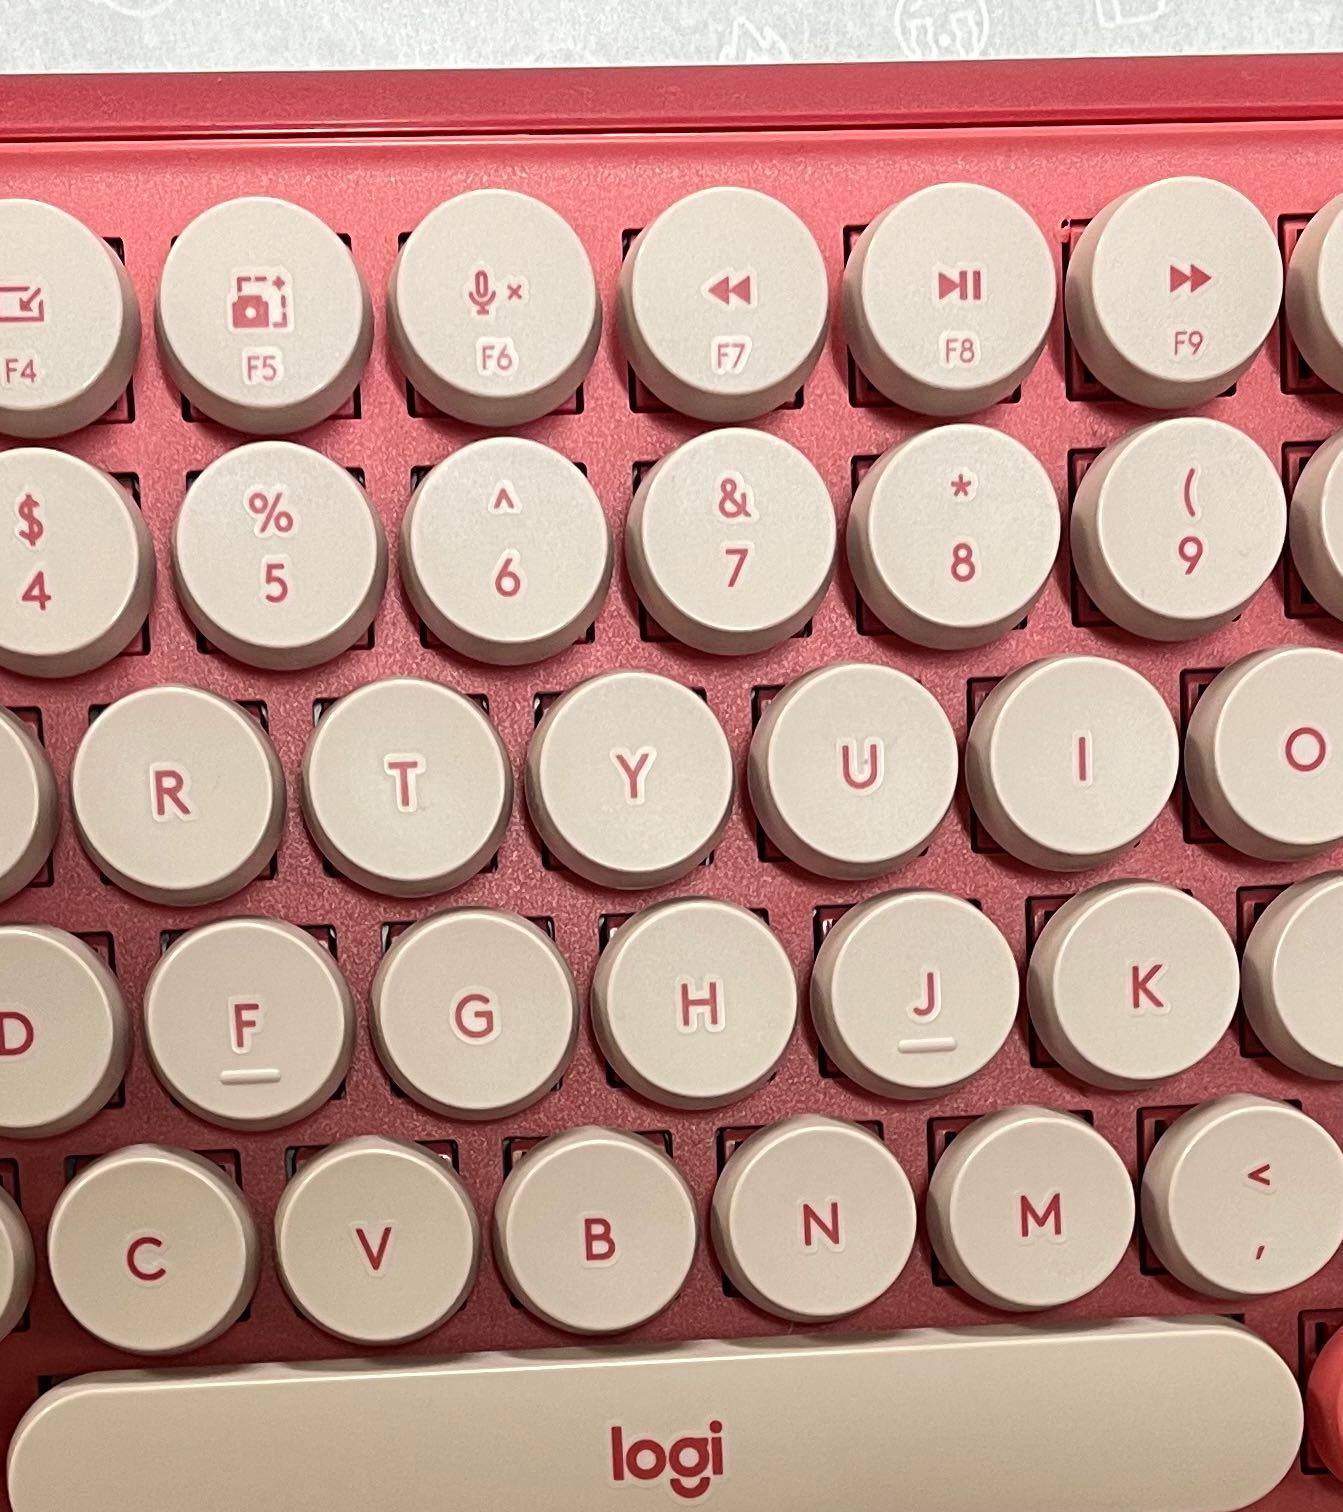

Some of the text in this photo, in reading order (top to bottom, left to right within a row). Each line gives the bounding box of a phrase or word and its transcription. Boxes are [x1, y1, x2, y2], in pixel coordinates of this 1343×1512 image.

[481, 345, 513, 371] F6
[717, 343, 746, 369] F7
[945, 337, 975, 364] F8
[1174, 330, 1204, 356] F9
[5, 358, 37, 384] F4
[247, 355, 277, 382] F5
[248, 492, 294, 533] %
[493, 487, 515, 509] ^
[718, 477, 752, 519] &
[1183, 467, 1196, 518] (
[18, 493, 44, 547] $
[494, 557, 521, 598] 6
[725, 548, 749, 588] 7
[950, 542, 976, 583] 8
[1178, 535, 1204, 576] 9
[21, 570, 52, 611] 4
[265, 563, 289, 604] 5
[841, 743, 878, 790] U
[1078, 736, 1087, 782] I
[1284, 726, 1327, 773] O
[154, 769, 191, 816] R
[388, 761, 418, 807] T
[615, 753, 649, 799] Y
[680, 981, 718, 1027] H
[913, 971, 935, 1017] J
[1131, 963, 1165, 1009] K
[234, 1003, 260, 1048] F
[454, 993, 494, 1039] G
[1247, 1163, 1271, 1186] <
[802, 1201, 840, 1247] N
[1020, 1192, 1062, 1238] M
[126, 1236, 167, 1281] C
[355, 1226, 392, 1271] V
[584, 1217, 616, 1262] B
[610, 1419, 724, 1499] logi
